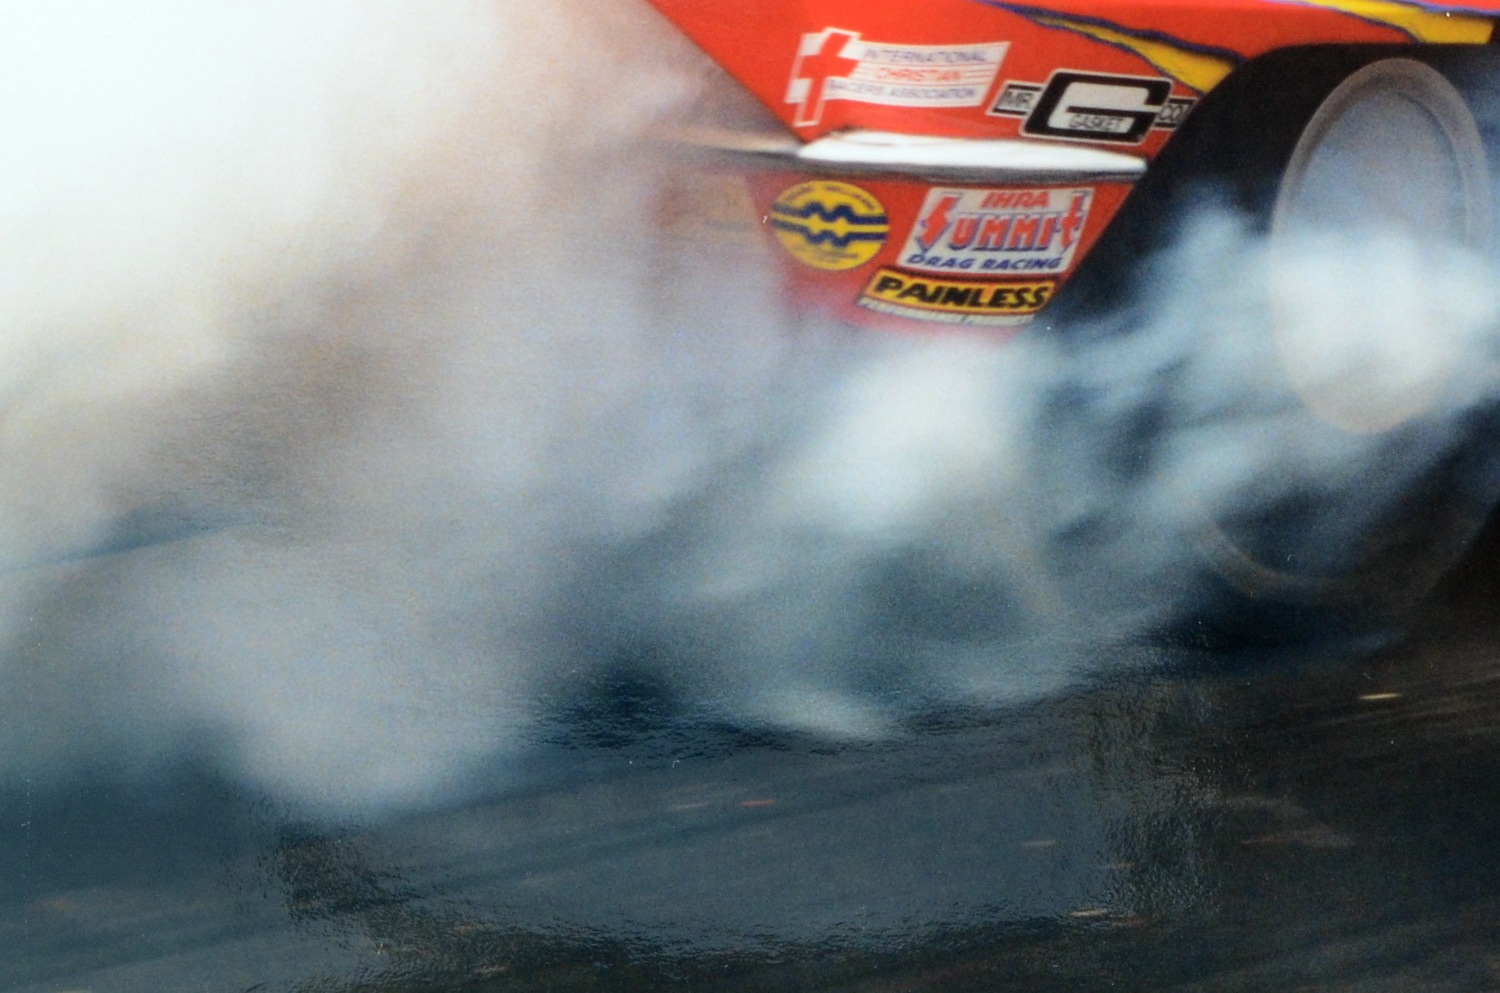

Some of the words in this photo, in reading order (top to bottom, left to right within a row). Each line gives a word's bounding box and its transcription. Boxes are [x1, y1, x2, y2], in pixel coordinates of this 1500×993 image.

[864, 47, 987, 64] INTERNATIONAL
[874, 67, 964, 83] CHRISTIAN
[980, 191, 1050, 208] IHRA
[914, 190, 1088, 255] SUMMIT
[906, 253, 976, 271] DRAG
[979, 256, 1063, 271] RACING
[873, 275, 1051, 309] PAINLESS
